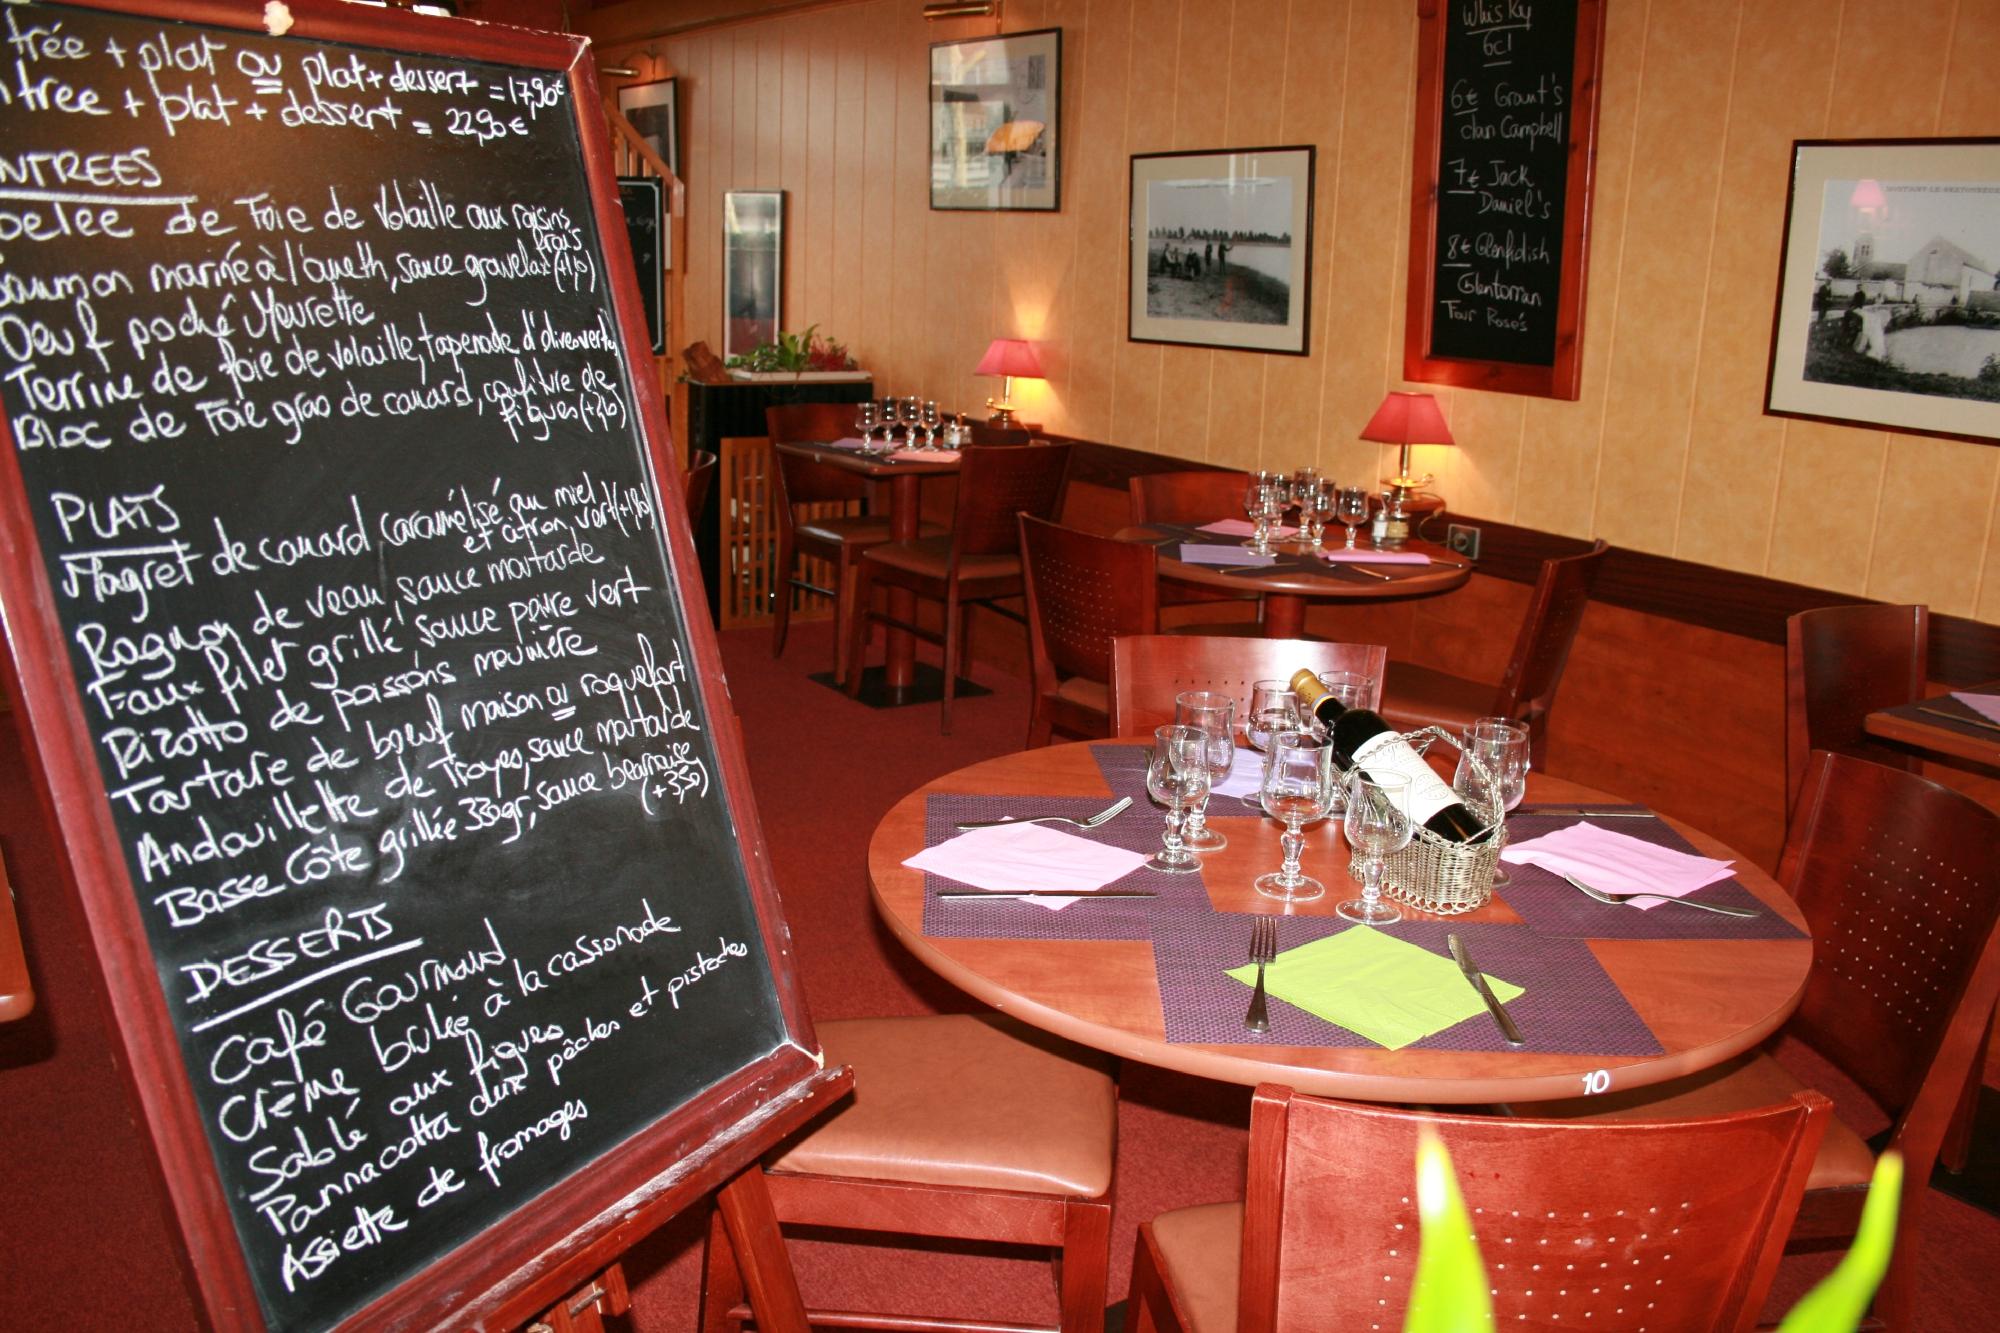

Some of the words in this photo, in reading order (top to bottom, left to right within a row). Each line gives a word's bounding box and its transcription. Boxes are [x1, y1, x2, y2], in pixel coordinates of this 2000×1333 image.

[138, 32, 227, 99] plat
[390, 60, 478, 95] dessert
[1494, 72, 1563, 107] Grant's
[159, 84, 238, 136] plat
[282, 89, 402, 130] dessert
[1501, 111, 1562, 152] Campbell
[165, 200, 236, 236] de
[324, 180, 364, 229] de
[466, 203, 506, 229] aux
[1478, 189, 1551, 220] Daniel's
[1487, 160, 1534, 187] Jack
[396, 252, 463, 283] sauce
[0, 299, 113, 373] Oeuf
[5, 363, 143, 411] Terrine
[152, 350, 208, 396] de
[218, 336, 278, 400] foie
[285, 333, 327, 378] de
[13, 412, 112, 450] Bloc
[129, 403, 187, 443] de
[272, 392, 331, 444] gras
[340, 381, 380, 417] de
[582, 362, 615, 392] de
[51, 484, 180, 543] PLATS
[61, 538, 204, 623] Magret
[211, 516, 260, 576] de
[259, 495, 372, 566] canard
[508, 492, 548, 516] au
[555, 471, 593, 508] miel
[463, 530, 492, 553] et
[76, 620, 235, 680] Rognon
[253, 590, 304, 635] de
[397, 573, 482, 605] sauce
[488, 526, 605, 583] moutarde
[415, 598, 501, 647] sauce
[508, 591, 579, 645] poivre
[586, 566, 651, 607] vert
[110, 748, 295, 814] Tartare
[307, 736, 359, 771] de
[461, 691, 543, 731] maison
[581, 633, 686, 718] roquefort
[270, 690, 324, 730] de
[331, 660, 457, 732] poissons
[137, 780, 378, 882] Andouillette
[385, 755, 437, 798] de
[528, 728, 594, 762] sauce
[597, 693, 700, 746] moutarde
[154, 874, 286, 927] Basse
[536, 772, 602, 810] sauce
[181, 902, 392, 1003] DESSERTS
[484, 978, 510, 1017] à
[514, 958, 548, 996] la
[547, 898, 681, 976] cassonade
[211, 999, 326, 1084] Café
[547, 1017, 621, 1086] pêches
[629, 976, 660, 1018] et
[668, 936, 748, 1010] pistaches
[249, 1092, 367, 1202] Sablé
[390, 1069, 453, 1115] aux
[469, 1024, 563, 1102] figues
[1581, 1069, 1610, 1095] 10
[282, 1205, 409, 1293] Assiette
[417, 1166, 466, 1208] de
[478, 1099, 588, 1187] fromages
